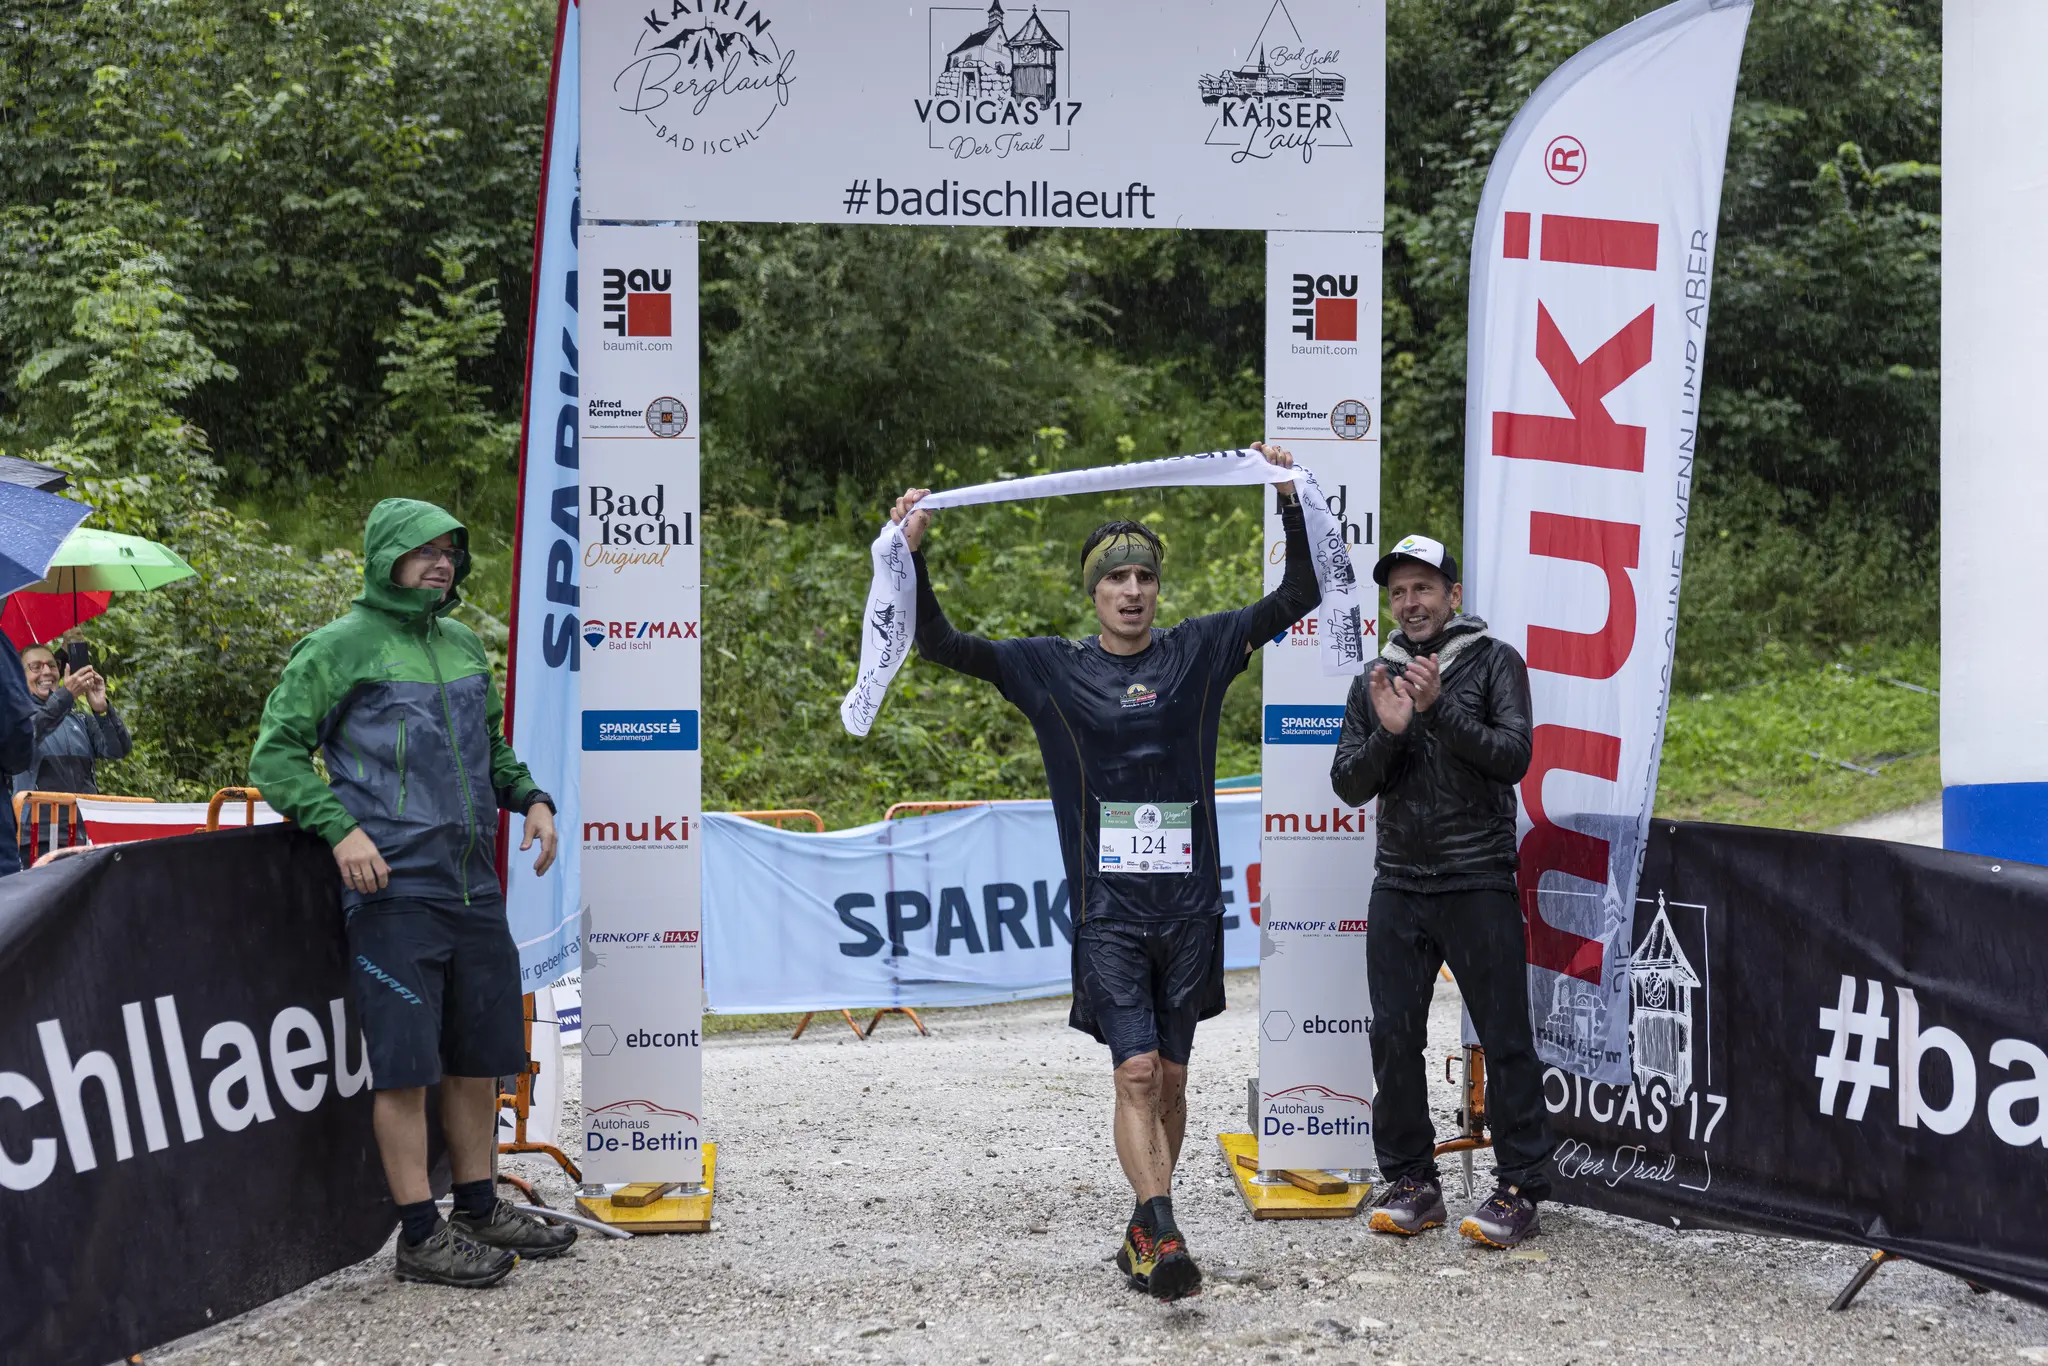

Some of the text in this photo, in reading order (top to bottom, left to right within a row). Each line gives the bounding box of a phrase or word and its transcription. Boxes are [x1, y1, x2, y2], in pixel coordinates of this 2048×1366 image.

[1269, 46, 1340, 71] Bad Ischl
[614, 49, 797, 115] Berglauf
[914, 99, 1082, 126] VOIGAS 17
[1222, 102, 1332, 129] KAISER
[656, 125, 759, 154] BAD ISCHL
[949, 132, 1044, 159] Der Trail
[1231, 117, 1317, 163] Lauf
[843, 178, 1155, 219] #badischllaeuft
[1685, 229, 1709, 330] ABER
[603, 340, 673, 351] baumit.com
[1291, 344, 1358, 355] baumit.com
[588, 399, 622, 408] Alfred
[588, 408, 643, 419] Kemptner
[1276, 402, 1308, 410] Alfred
[1276, 410, 1328, 420] Kemptner
[588, 484, 665, 517] Bad
[598, 512, 694, 546] Ischl
[584, 542, 671, 574] Original
[1492, 211, 1660, 986] muki
[608, 621, 698, 639] RE/MAX
[1342, 615, 1357, 659] KAISER
[609, 641, 652, 650] Bad Ischl
[1291, 638, 1308, 646] Bad
[599, 723, 668, 734] SPARKASSE
[599, 734, 653, 743] Salzkammergut
[1281, 728, 1332, 736] Salzkammergut
[583, 815, 689, 842] muki
[1265, 808, 1366, 832] muki
[1131, 835, 1167, 854] 124
[1268, 921, 1326, 931] PERNKOPF
[1328, 921, 1337, 931] &
[588, 931, 697, 943] PERNKOPF & HAAS
[356, 954, 423, 1005] DYNAFIT
[1303, 1015, 1372, 1033] ebcont
[626, 1029, 699, 1047] ebcont
[1814, 974, 2048, 1149] #ba
[1269, 1104, 1324, 1114] Autohaus
[1543, 1067, 1728, 1143] OIGAS 17
[591, 1119, 650, 1129] Autohaus
[1264, 1115, 1370, 1136] De-Bettin
[587, 1130, 697, 1151] De-Bettin
[1553, 1138, 1676, 1187] Der Trail
